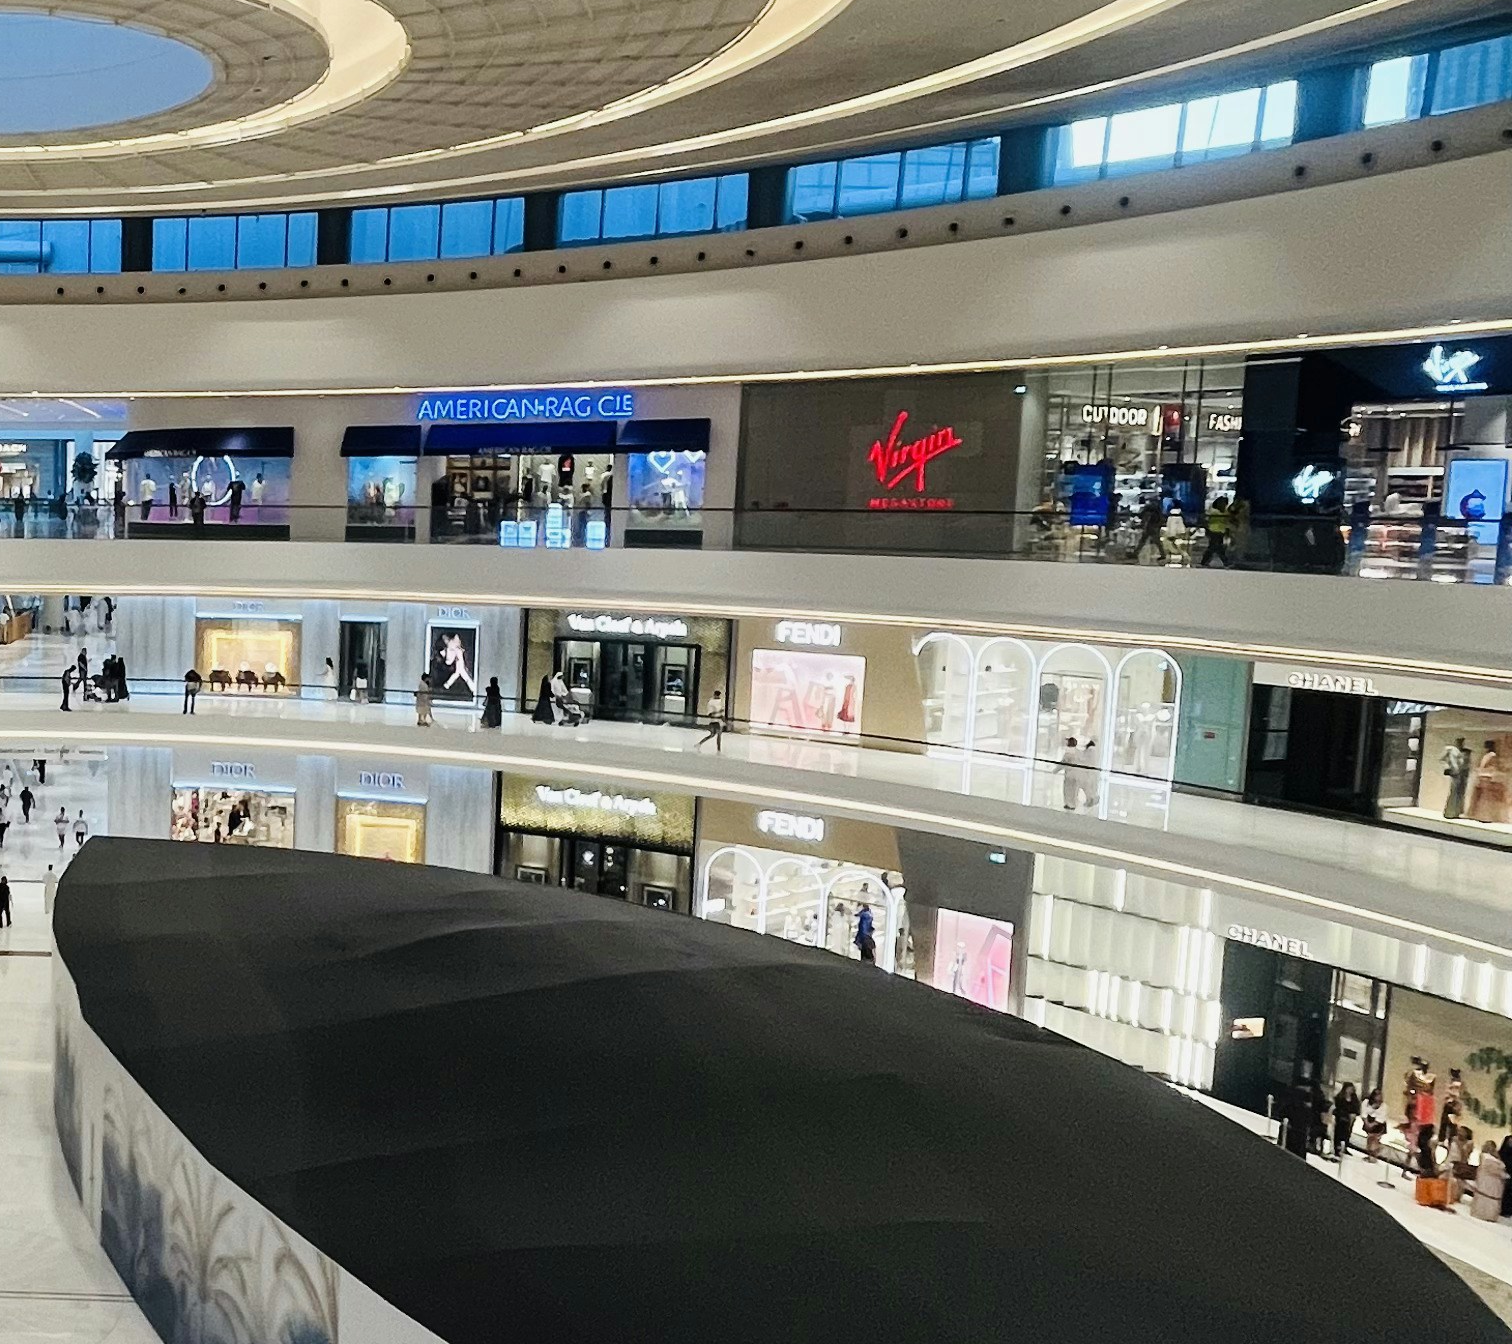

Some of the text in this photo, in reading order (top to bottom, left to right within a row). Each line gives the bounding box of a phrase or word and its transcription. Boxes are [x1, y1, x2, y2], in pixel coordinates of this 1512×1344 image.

[868, 411, 963, 492] Virgin
[437, 607, 471, 620] DIOR
[775, 620, 841, 646] FENDI
[1288, 672, 1379, 696] CHANEL
[211, 761, 256, 779] DIOR
[359, 770, 406, 789] DIOR
[757, 810, 824, 841] FENDI
[1228, 924, 1314, 960] CHANEL
